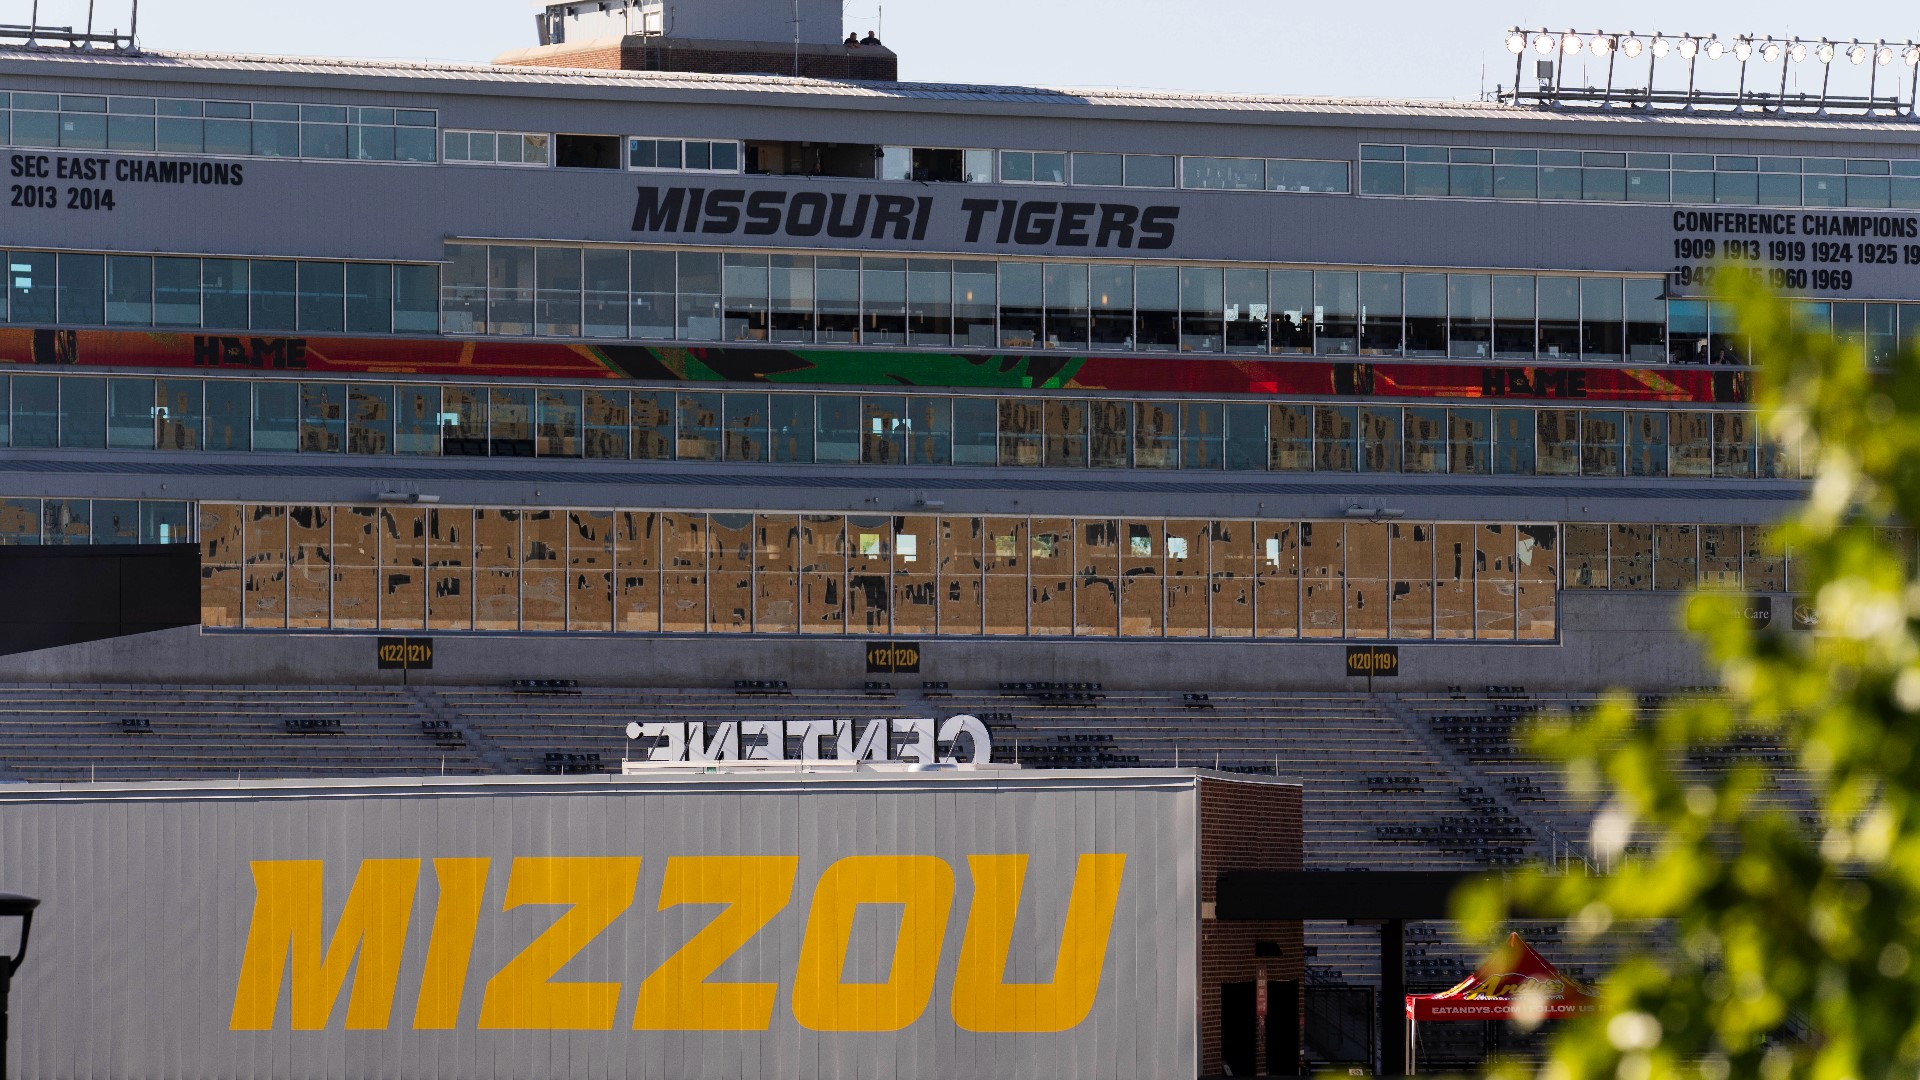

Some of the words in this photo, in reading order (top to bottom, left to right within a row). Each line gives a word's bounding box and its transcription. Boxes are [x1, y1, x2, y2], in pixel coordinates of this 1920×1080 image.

[11, 154, 49, 178] SEC
[57, 157, 110, 180] EAST
[115, 159, 243, 185] CHAMPIONS
[11, 185, 57, 208] 2013
[67, 187, 115, 211] 2014
[631, 186, 934, 241] MISSOURI
[961, 199, 1181, 250] TIGERS
[1673, 211, 1796, 235] CONFERENCE
[1802, 215, 1918, 238] CHAMPIONS
[1674, 238, 1715, 259] 1909
[1723, 239, 1761, 261] 1913
[1768, 241, 1806, 262] 1919
[1811, 242, 1853, 263] 1924
[1857, 243, 1898, 265] 1925
[1674, 265, 1715, 287] 1942
[1768, 268, 1807, 289] 1960
[1811, 269, 1853, 291] 1969
[1743, 607, 1769, 619] Care
[383, 644, 404, 661] 122
[407, 644, 425, 661] 121
[874, 649, 892, 666] 121
[895, 649, 914, 666] 120
[1352, 653, 1371, 669] 120
[1374, 653, 1391, 669] 119
[229, 853, 1127, 1032] MIZZOU
[1432, 1005, 1521, 1014] EATANDYS.COM
